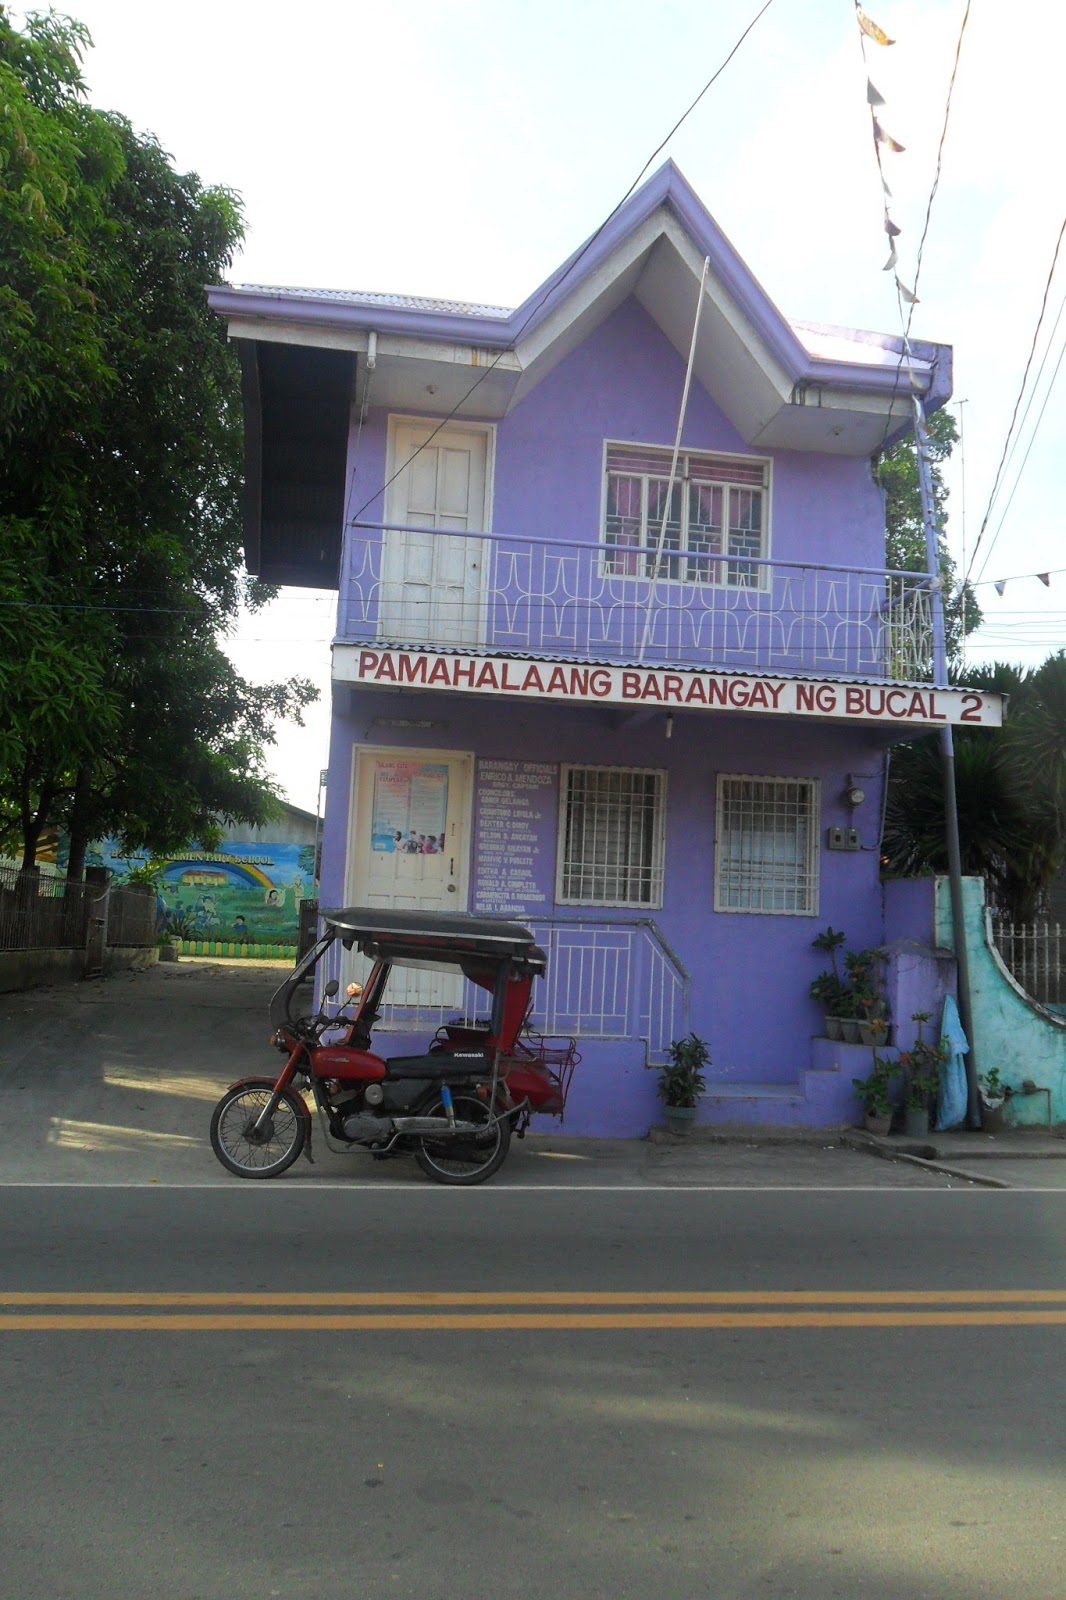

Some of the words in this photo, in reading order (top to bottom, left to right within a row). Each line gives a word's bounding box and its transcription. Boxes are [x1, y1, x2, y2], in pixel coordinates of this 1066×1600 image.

[358, 651, 611, 697] PAMAHALAANG
[622, 671, 786, 708] BARANGAY
[796, 684, 836, 713] NG
[845, 688, 947, 720] BUCAL
[960, 694, 984, 722] 2
[479, 760, 519, 771] BARANGAY
